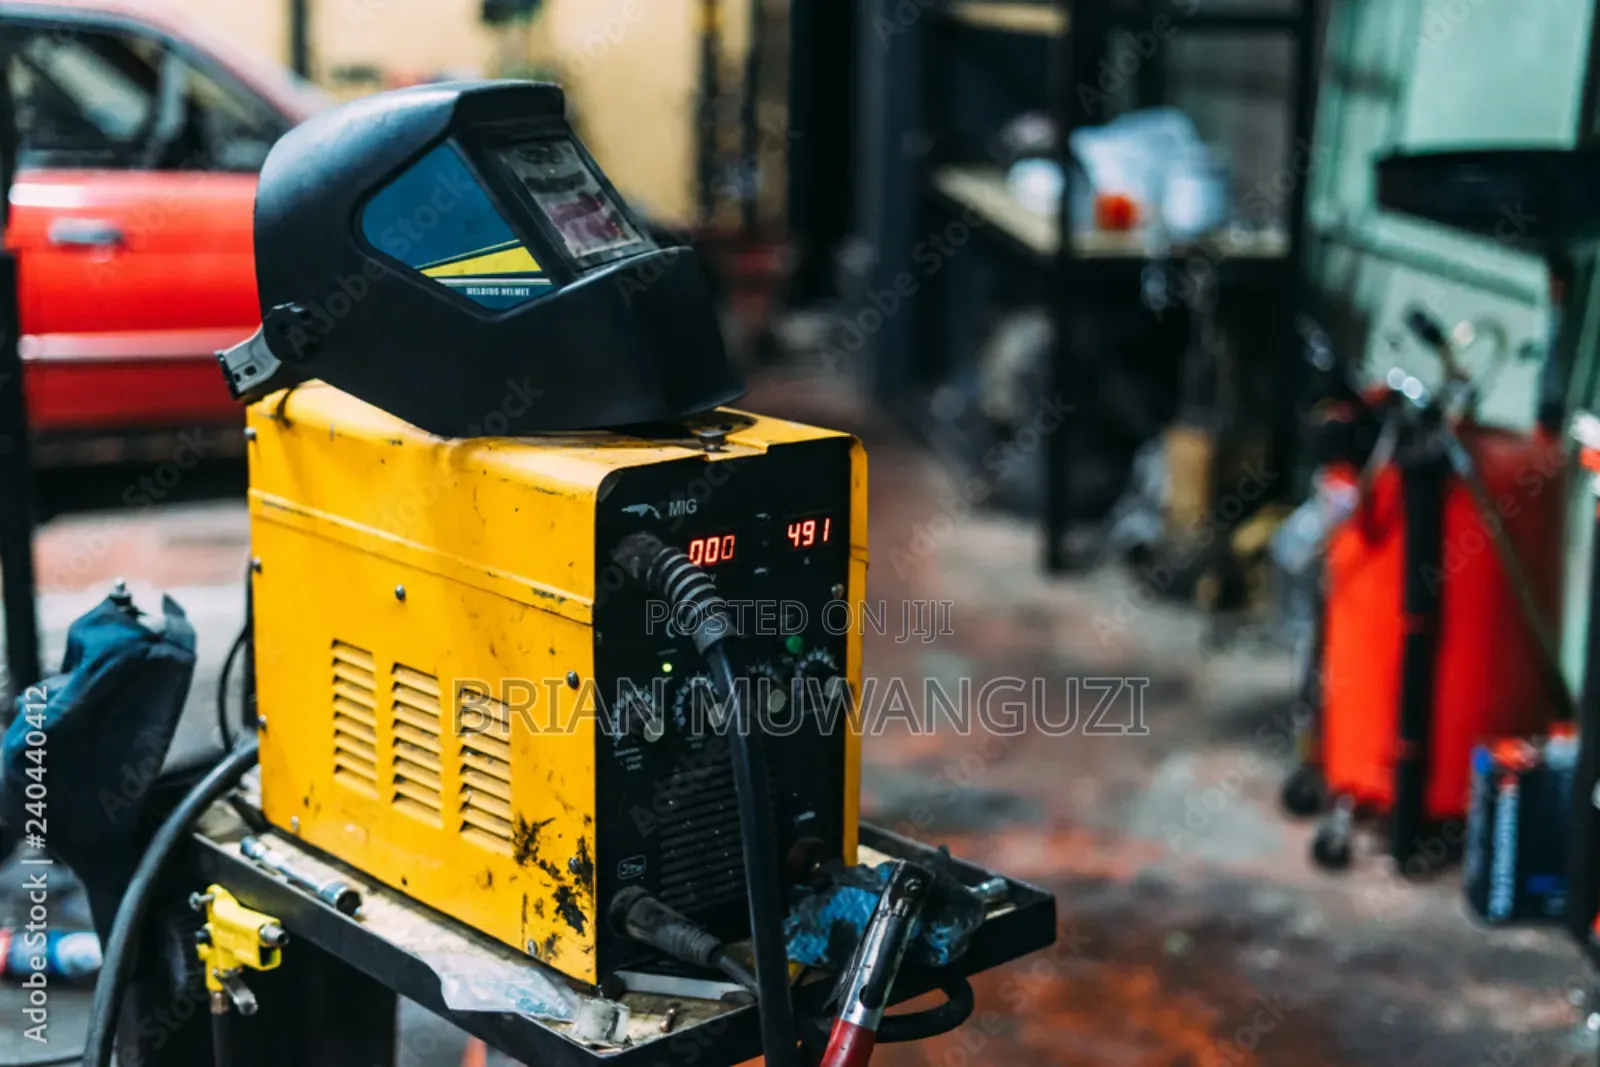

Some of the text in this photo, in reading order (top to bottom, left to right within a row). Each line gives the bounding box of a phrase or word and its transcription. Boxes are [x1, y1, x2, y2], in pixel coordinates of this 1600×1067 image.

[466, 287, 530, 297] WELDING HELMET
[668, 497, 697, 517] MIG
[786, 515, 832, 549] 491
[688, 532, 737, 566] 000
